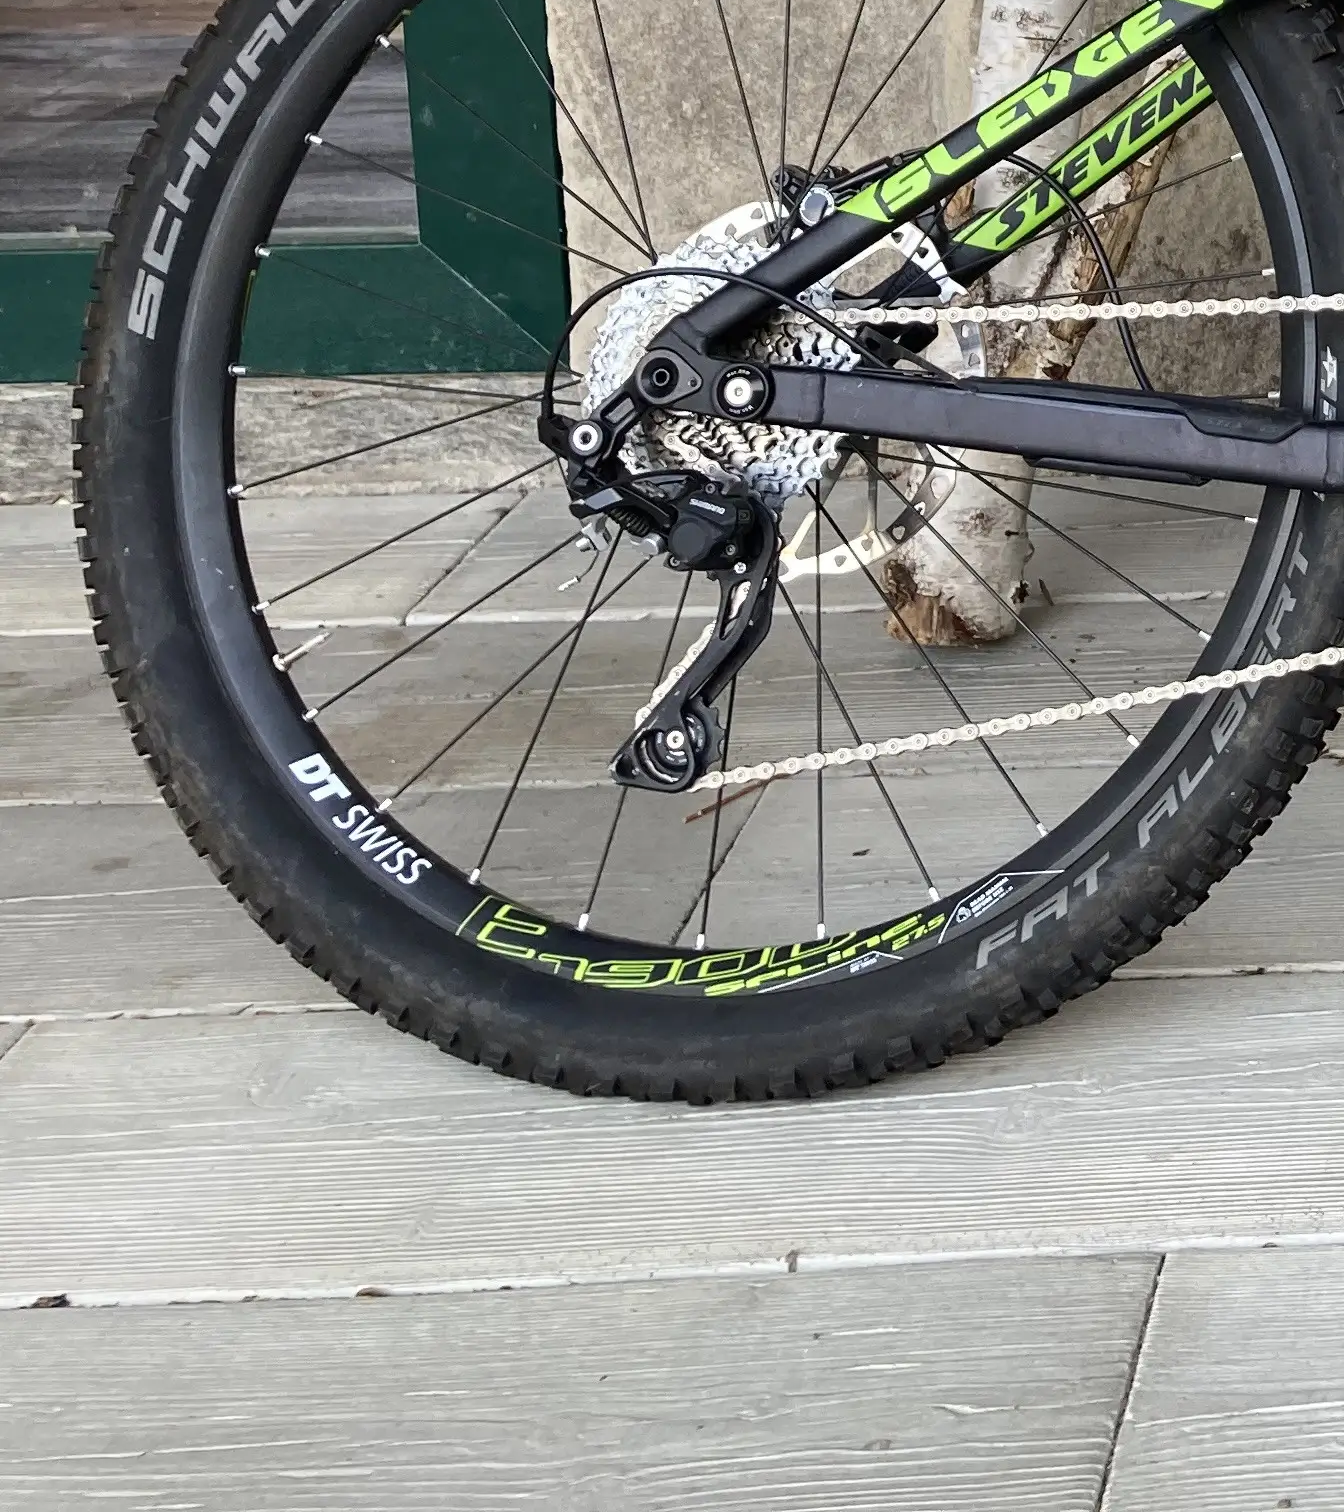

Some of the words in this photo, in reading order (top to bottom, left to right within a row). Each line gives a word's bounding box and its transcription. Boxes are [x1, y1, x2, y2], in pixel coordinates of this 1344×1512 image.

[876, 0, 1177, 214] SLEDGE
[994, 64, 1213, 248] STEVEN
[288, 752, 353, 801] DT
[331, 802, 433, 886] SWISS
[891, 912, 946, 952] 27.5
[975, 850, 1110, 971] FAT
